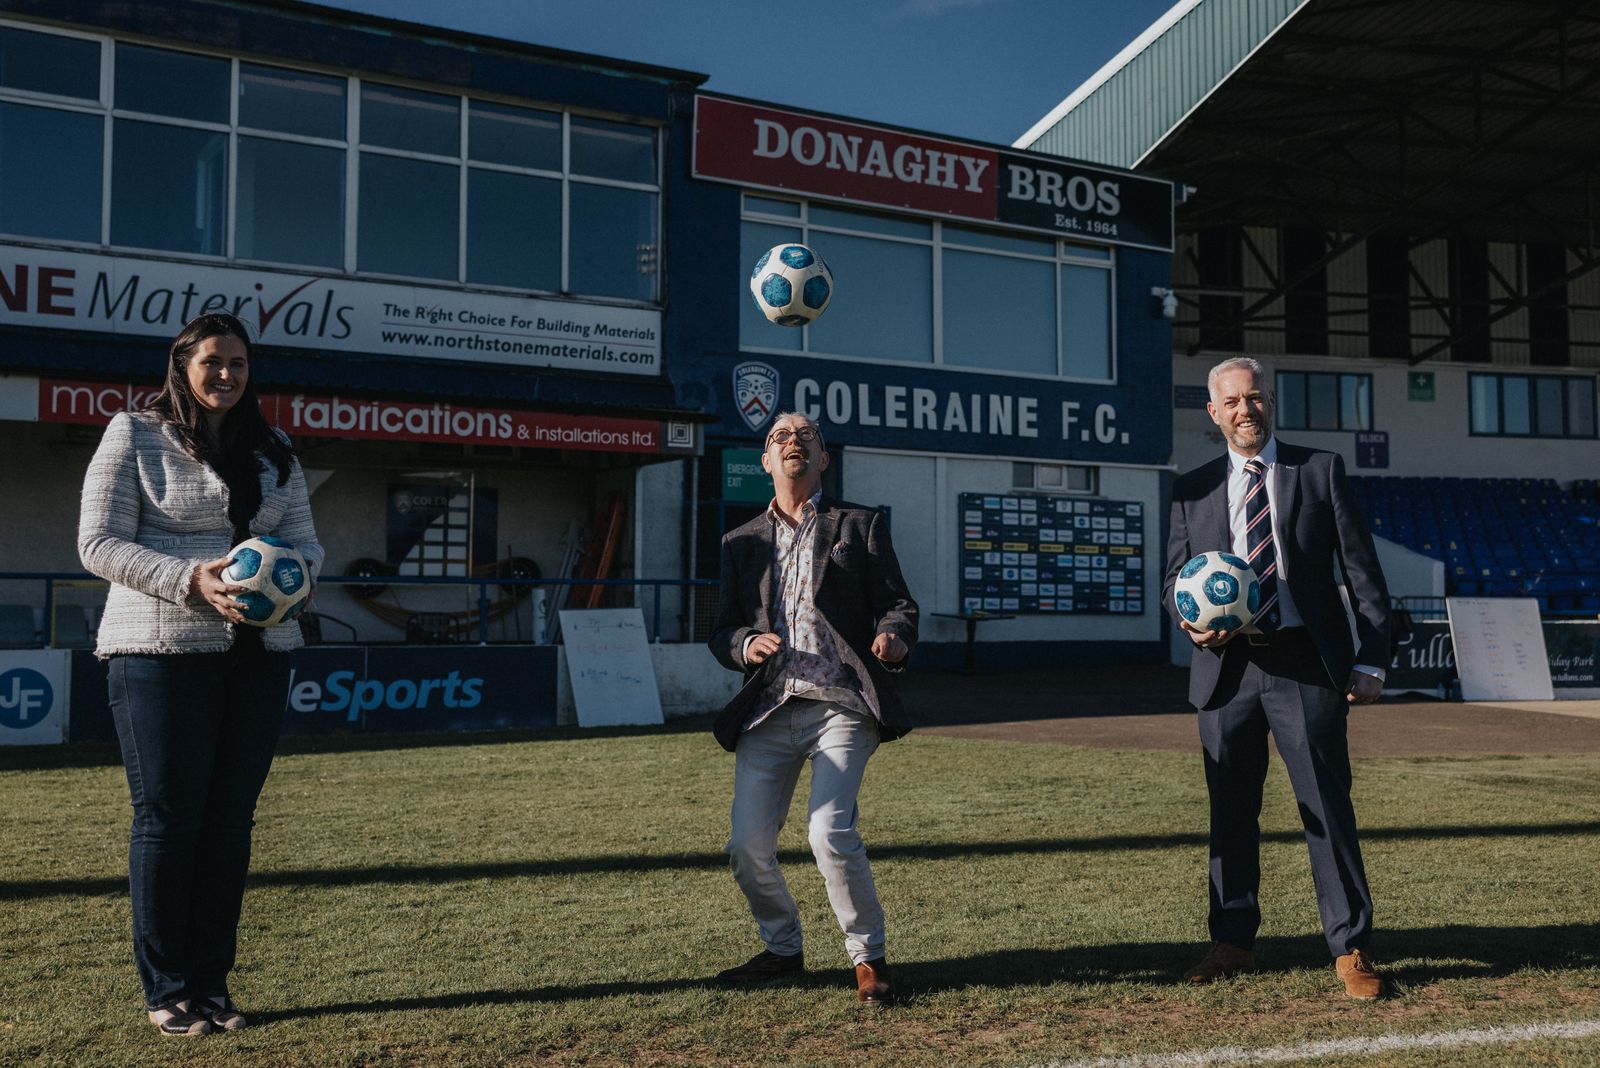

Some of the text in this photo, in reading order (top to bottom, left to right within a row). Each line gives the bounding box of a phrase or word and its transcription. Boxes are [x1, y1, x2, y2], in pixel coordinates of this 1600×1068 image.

[753, 118, 1120, 216] DONAGHY BROS
[1054, 213, 1118, 237] Est. 1964
[88, 271, 355, 340] Materials
[383, 303, 656, 341] The Right Choice For Building Materials
[381, 329, 655, 365] www.northstonematerials.com
[291, 397, 513, 439] fabrications
[517, 423, 530, 439] &
[535, 423, 629, 446] installations
[631, 430, 656, 447] ltd.
[794, 378, 1130, 445] COLERAINE F.C.
[727, 463, 764, 476] EMERGENC
